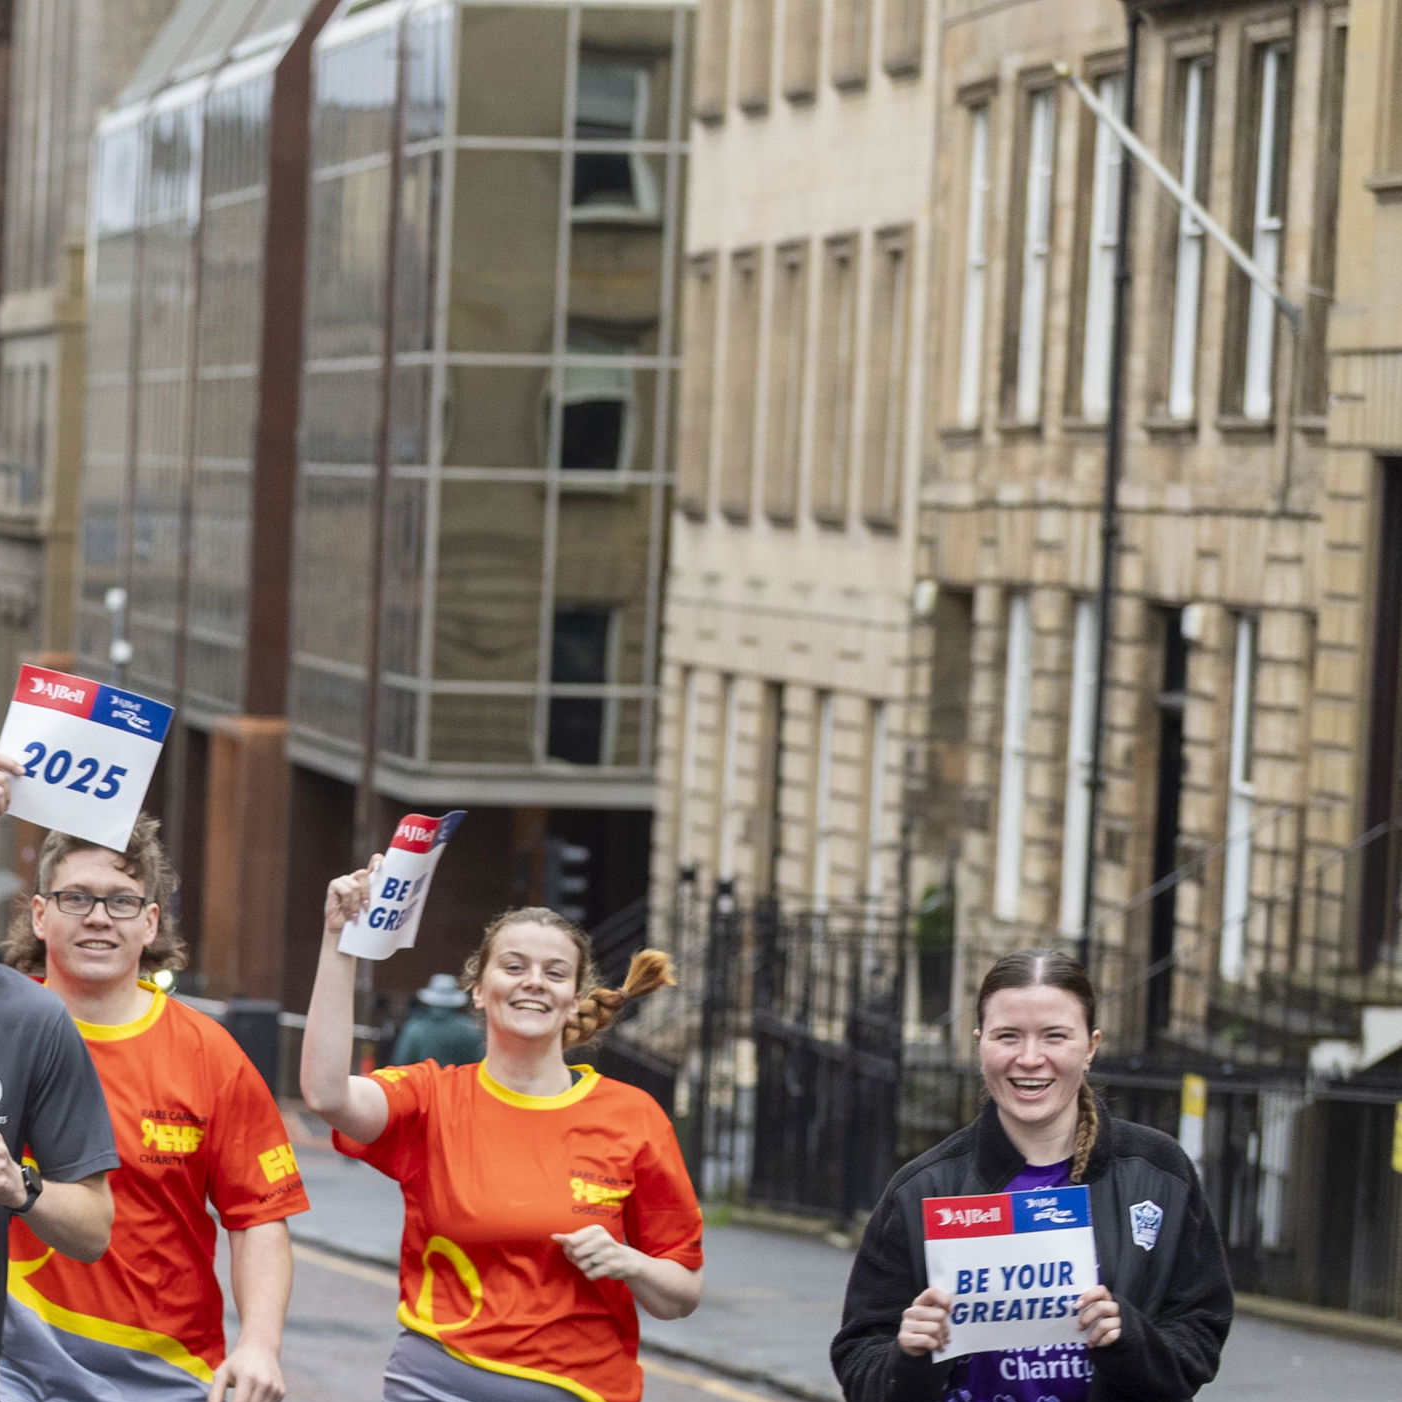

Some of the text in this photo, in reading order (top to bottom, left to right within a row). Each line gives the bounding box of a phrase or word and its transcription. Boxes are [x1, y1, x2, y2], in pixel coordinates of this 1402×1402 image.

[22, 741, 129, 800] 2025
[381, 876, 411, 902] BE
[956, 1261, 1073, 1295] BE YOUR
[951, 1294, 1084, 1325] GREATEST
